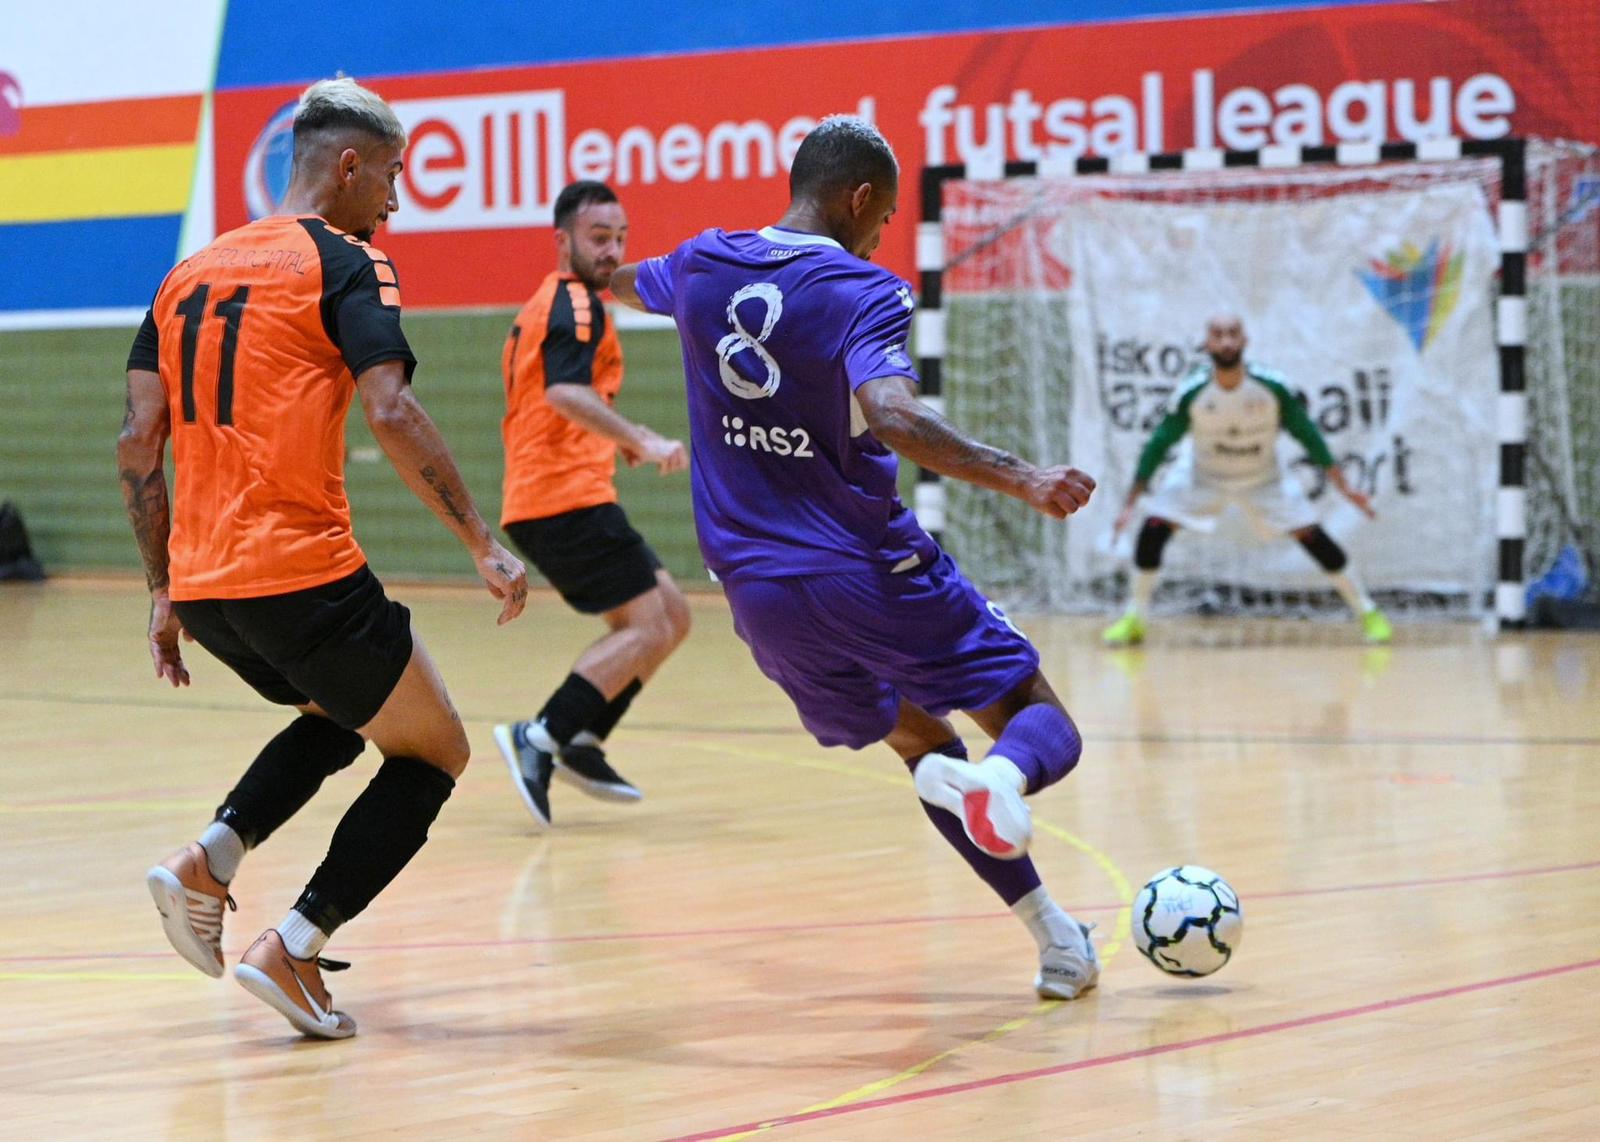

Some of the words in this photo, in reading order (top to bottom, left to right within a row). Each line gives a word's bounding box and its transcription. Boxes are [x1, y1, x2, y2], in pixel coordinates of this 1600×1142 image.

[570, 96, 876, 184] eneme
[920, 72, 1163, 166] futsal
[1193, 69, 1516, 156] league
[174, 284, 250, 426] 11
[715, 282, 784, 399] 8
[750, 425, 814, 458] RS2
